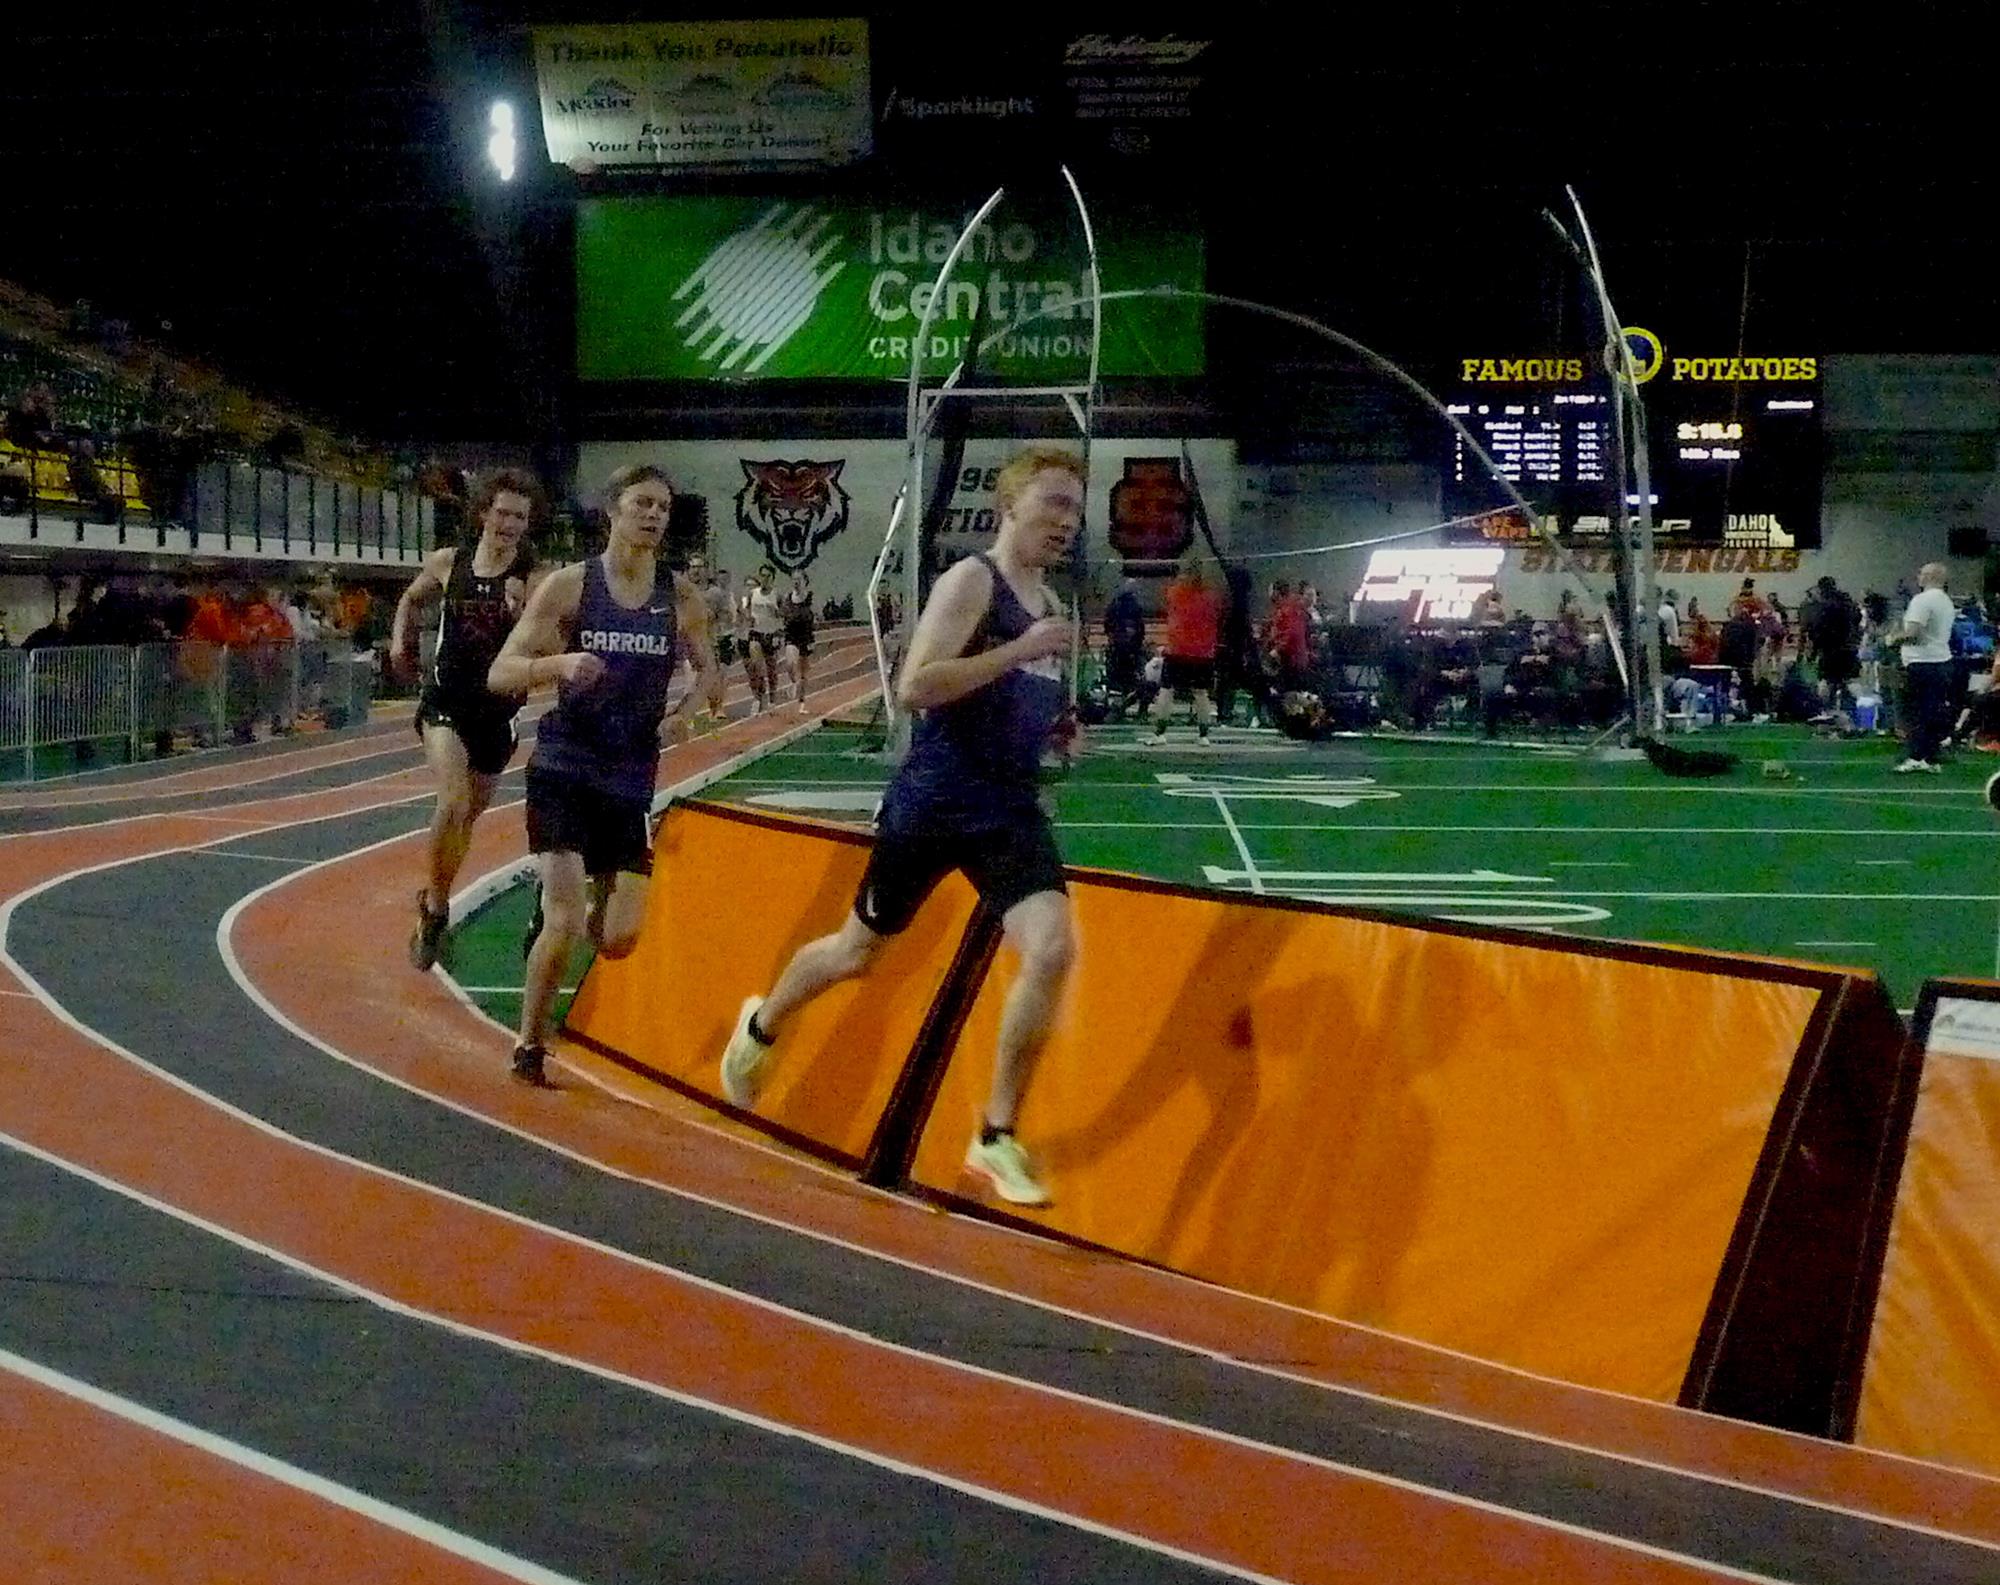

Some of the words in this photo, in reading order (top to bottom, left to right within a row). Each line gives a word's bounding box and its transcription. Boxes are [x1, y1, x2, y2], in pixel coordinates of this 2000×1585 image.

[641, 124, 669, 136] For
[588, 140, 630, 153] Your
[869, 211, 1036, 264] Idaho
[868, 269, 1094, 322] Central
[868, 336, 973, 359] CRDI
[1462, 359, 1583, 382] FAMOUS
[1672, 357, 1817, 381] POTATOES
[580, 630, 668, 656] CARROLL
